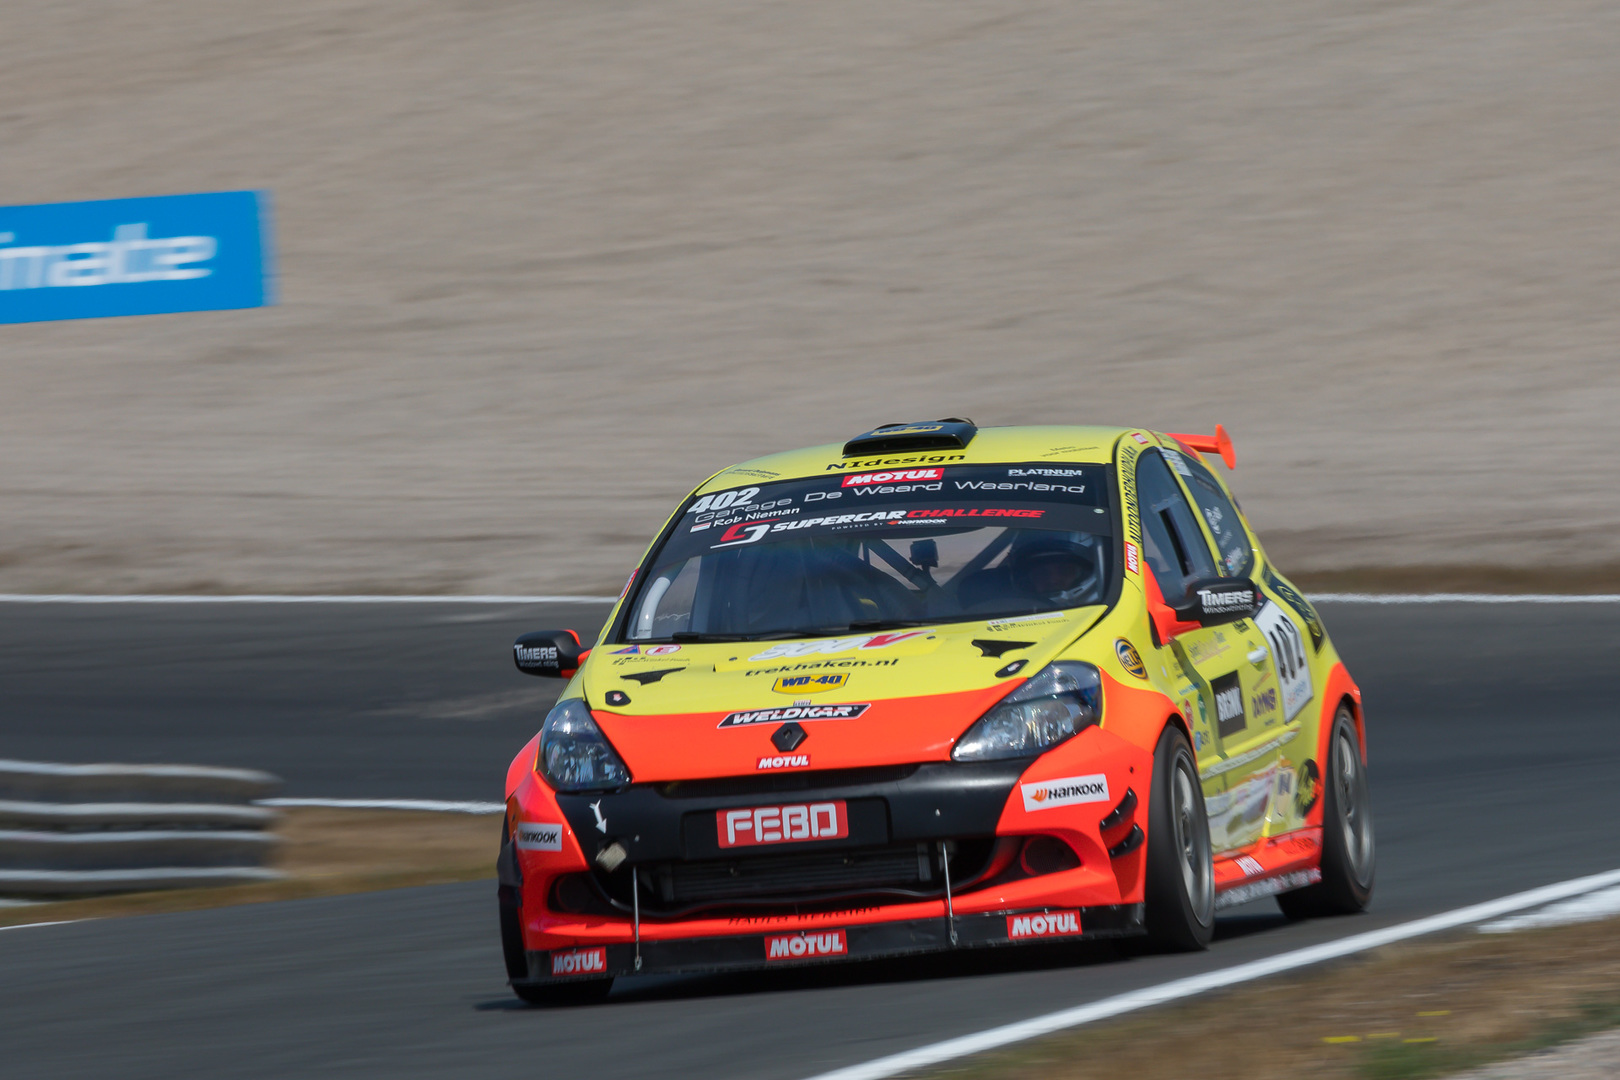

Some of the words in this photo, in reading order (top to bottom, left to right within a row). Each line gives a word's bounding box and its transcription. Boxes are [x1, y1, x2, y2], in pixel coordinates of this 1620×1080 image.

[846, 469, 939, 485] MOTUL
[1008, 468, 1083, 476] PLATINUM
[687, 487, 760, 514] 402
[694, 498, 792, 523] Garage
[804, 491, 842, 503] De
[853, 482, 943, 496] Waard
[955, 481, 1086, 494] Waarland
[713, 516, 742, 528] Rob
[745, 507, 800, 523] Nieman
[770, 509, 908, 533] SUPERCAR
[906, 508, 1046, 518] CHALLENGE
[745, 658, 899, 677] trekhaken.nl
[781, 674, 843, 688] WD-40
[732, 706, 853, 724] WELDKAR
[758, 755, 809, 769] MOTUL
[726, 803, 838, 845] FEBO
[1012, 914, 1079, 937] MOTUL
[769, 933, 843, 957] MOTUL
[553, 951, 604, 974] MOTUL
